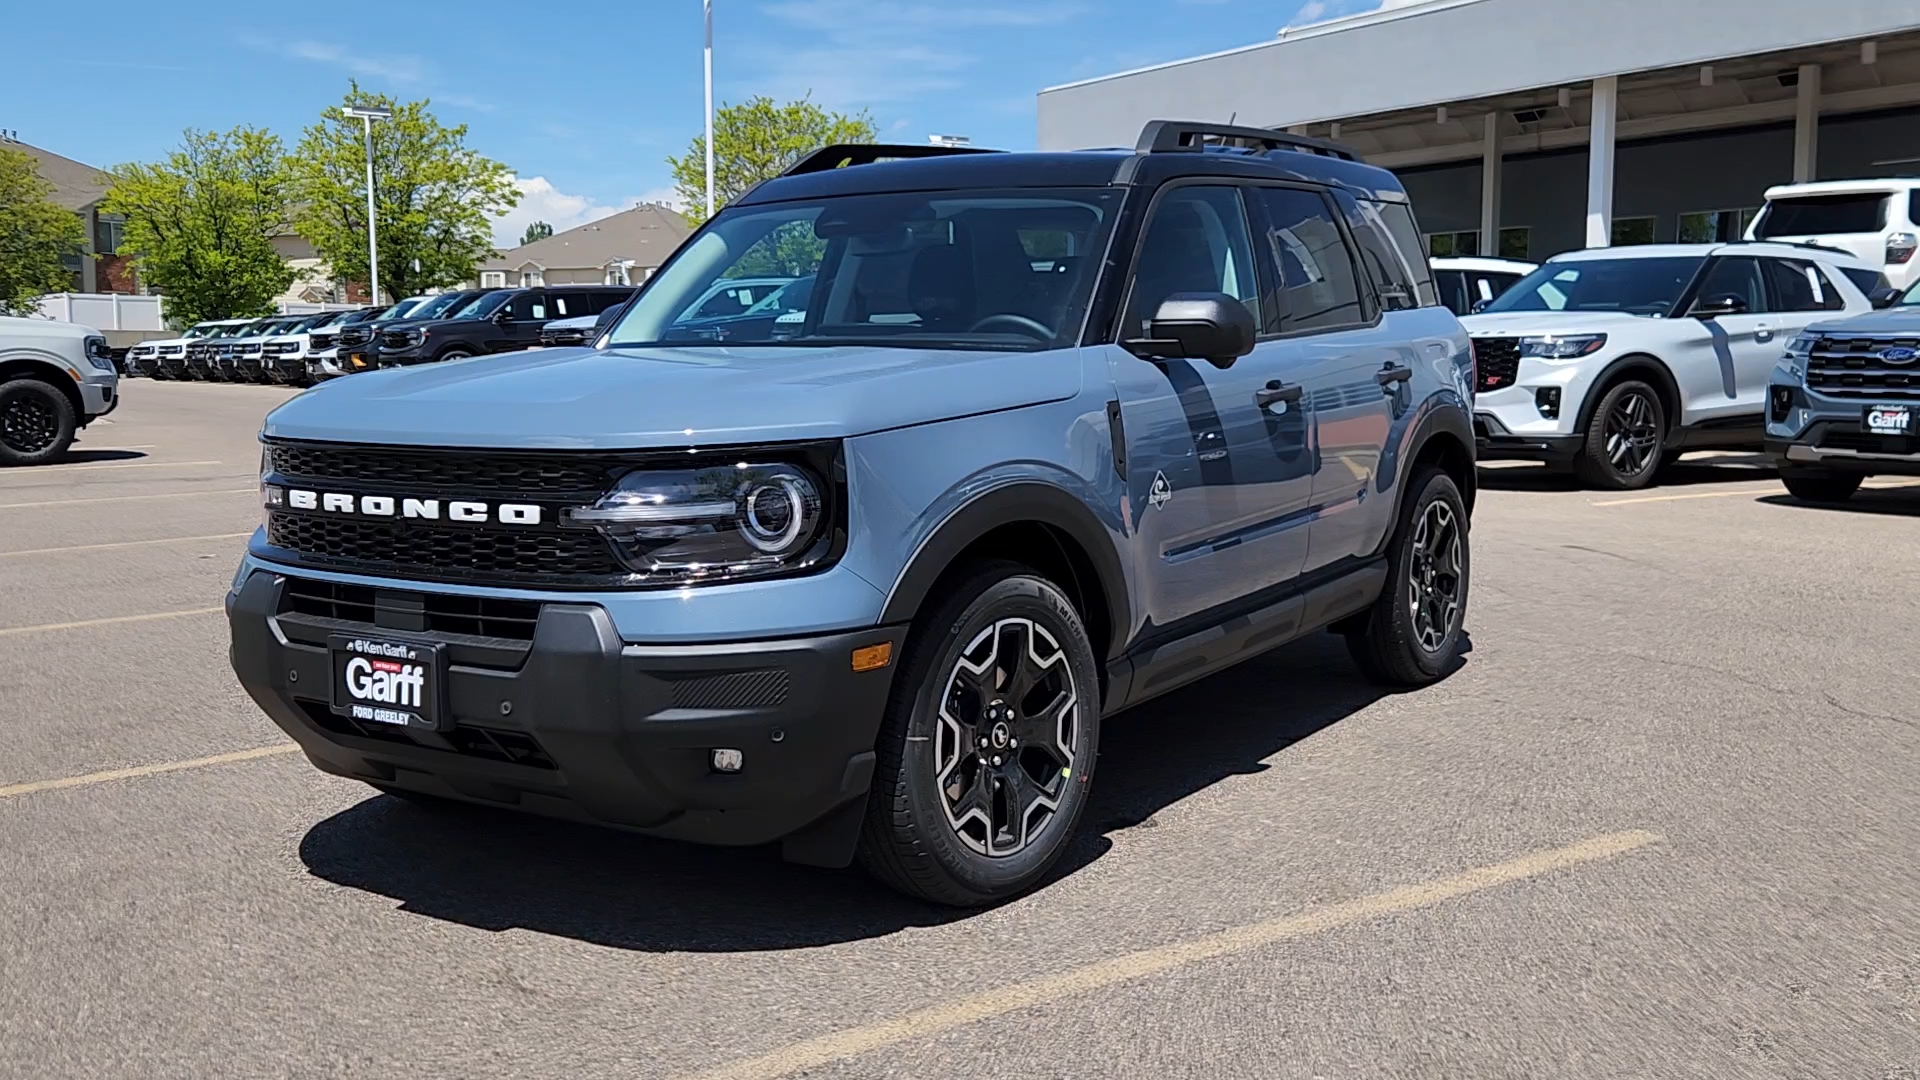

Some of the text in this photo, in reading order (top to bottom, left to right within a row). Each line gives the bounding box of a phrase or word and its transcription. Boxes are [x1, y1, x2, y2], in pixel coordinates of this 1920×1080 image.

[1868, 410, 1910, 429] Garff
[289, 489, 541, 525] BRONCO
[346, 656, 424, 707] Garff
[352, 705, 410, 726] FORD GREELEY
